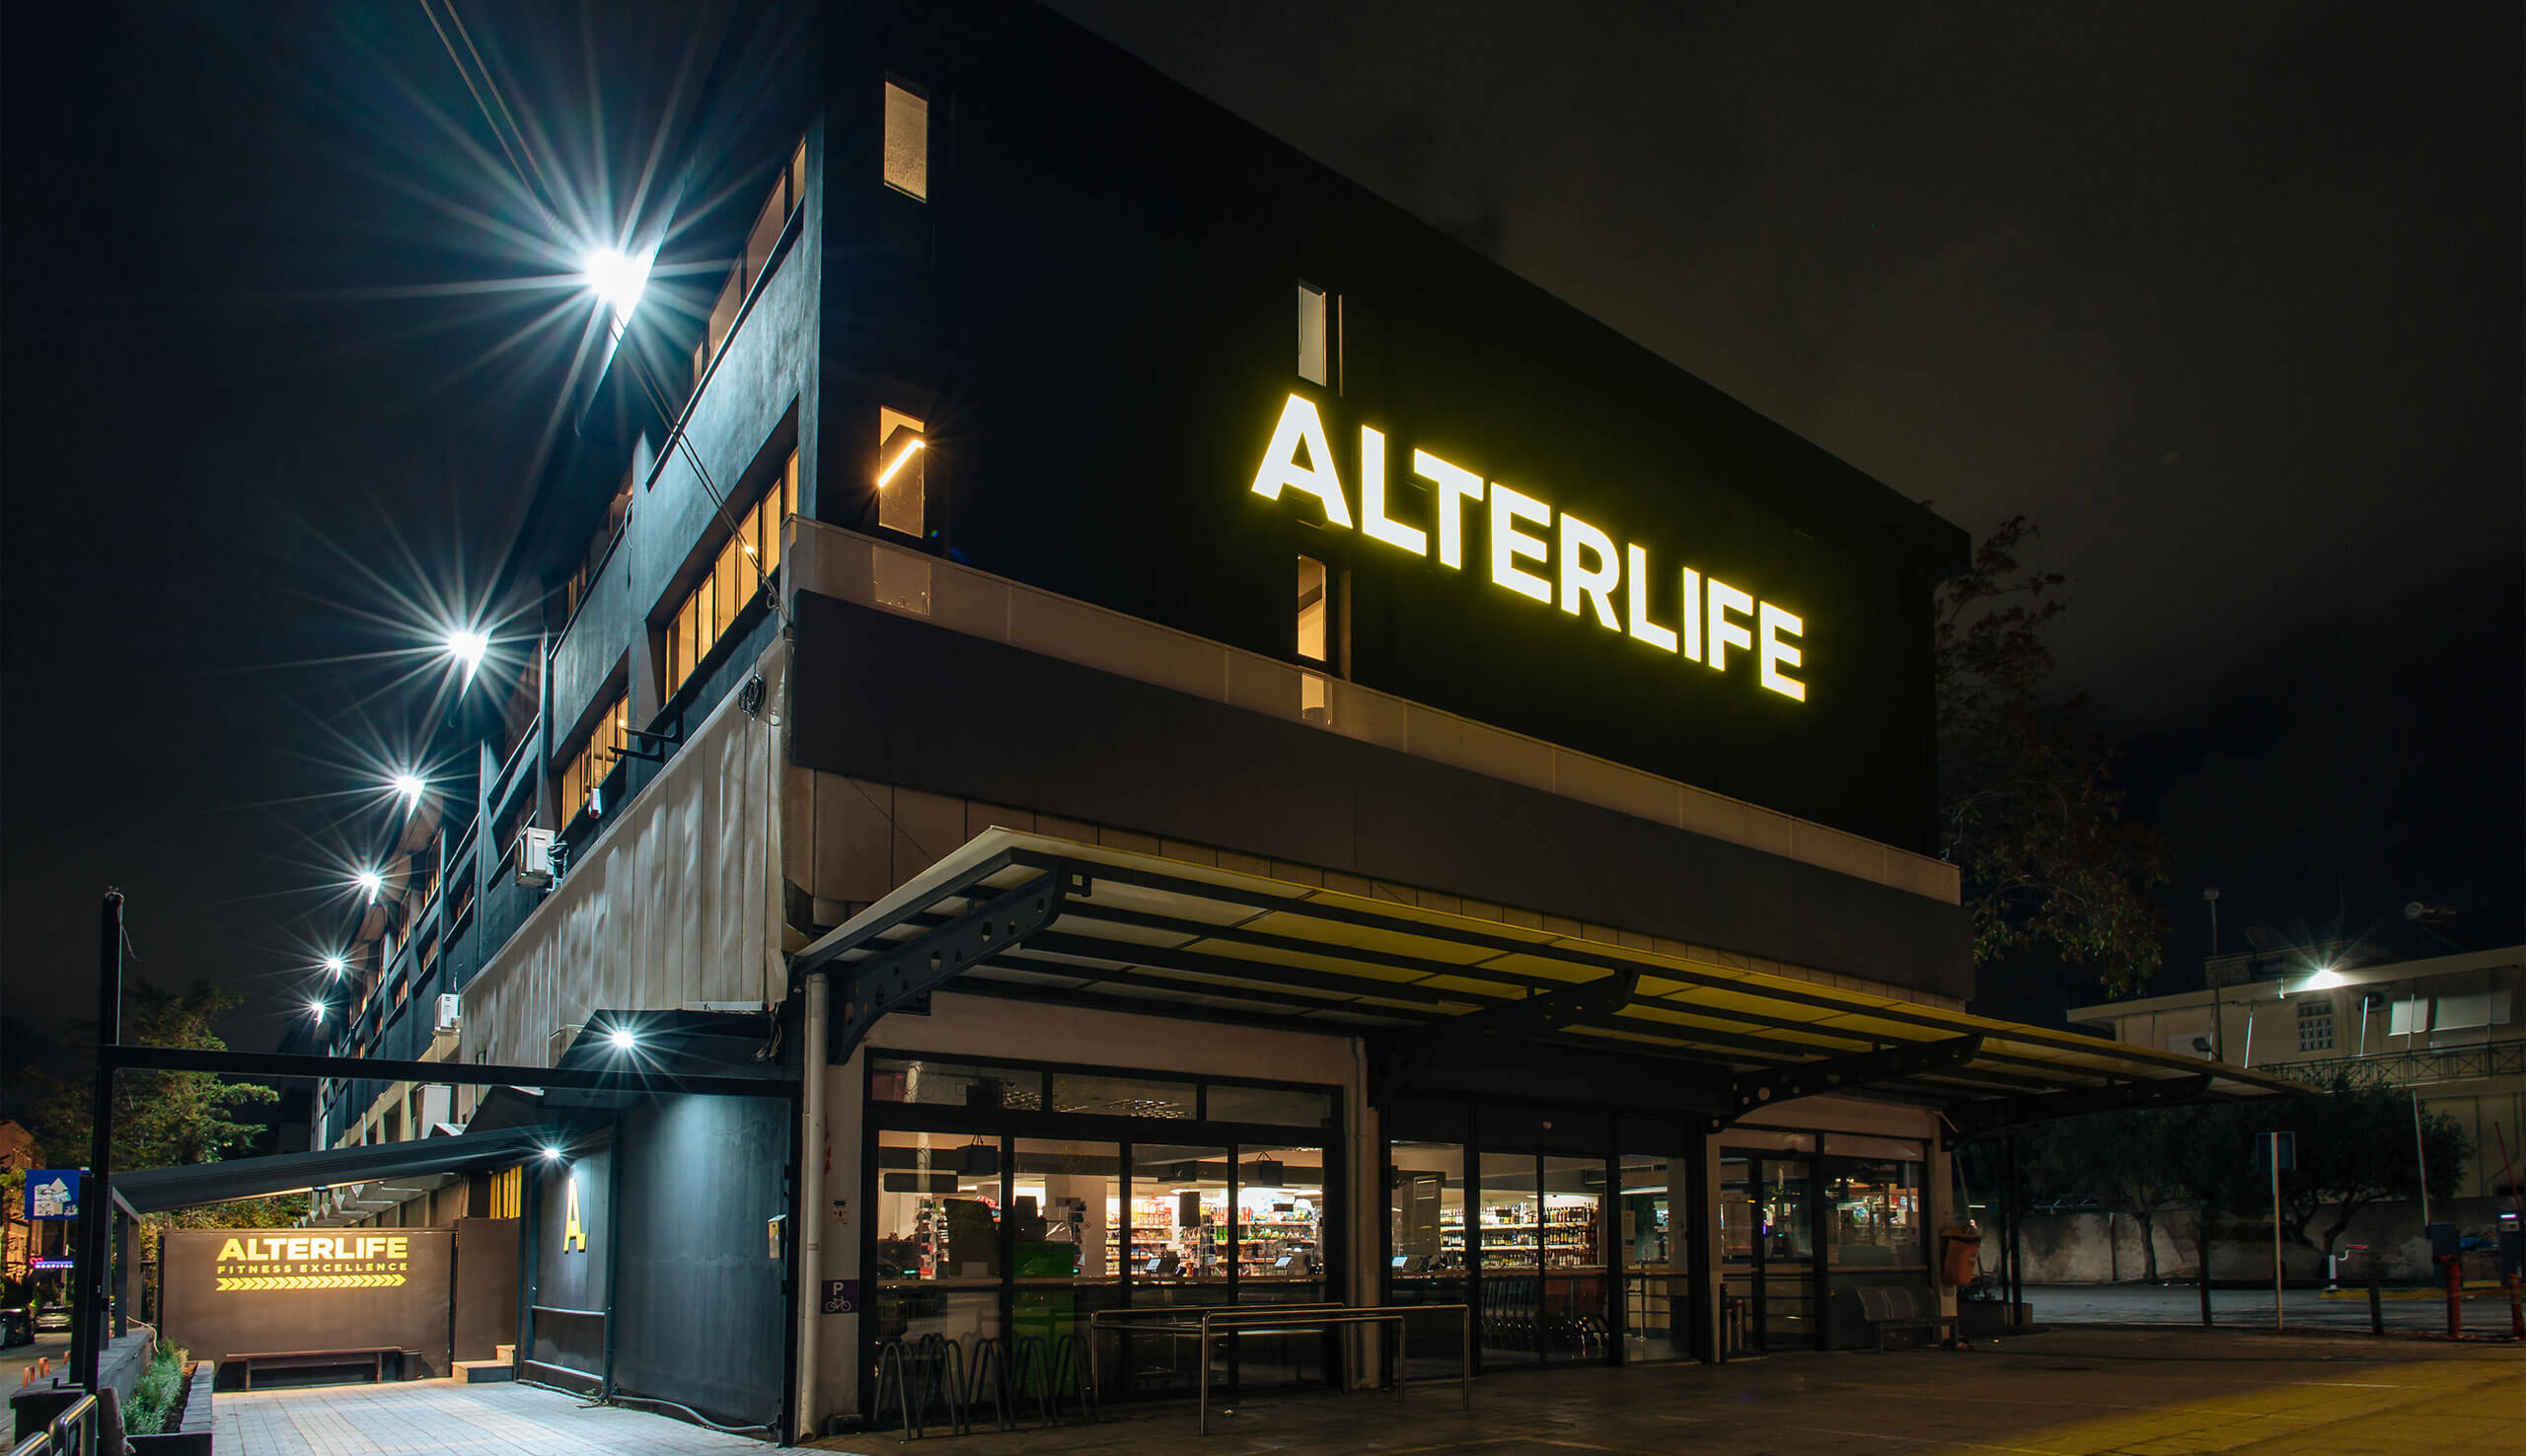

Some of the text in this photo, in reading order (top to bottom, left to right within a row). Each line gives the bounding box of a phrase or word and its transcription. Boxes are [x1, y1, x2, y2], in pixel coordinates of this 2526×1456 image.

[1250, 393, 1806, 703] ALTERLIFE
[216, 1236, 409, 1262] ALTERLIFE
[217, 1262, 408, 1275] FITNESS EXCELLENCE
[833, 1281, 845, 1296] P
